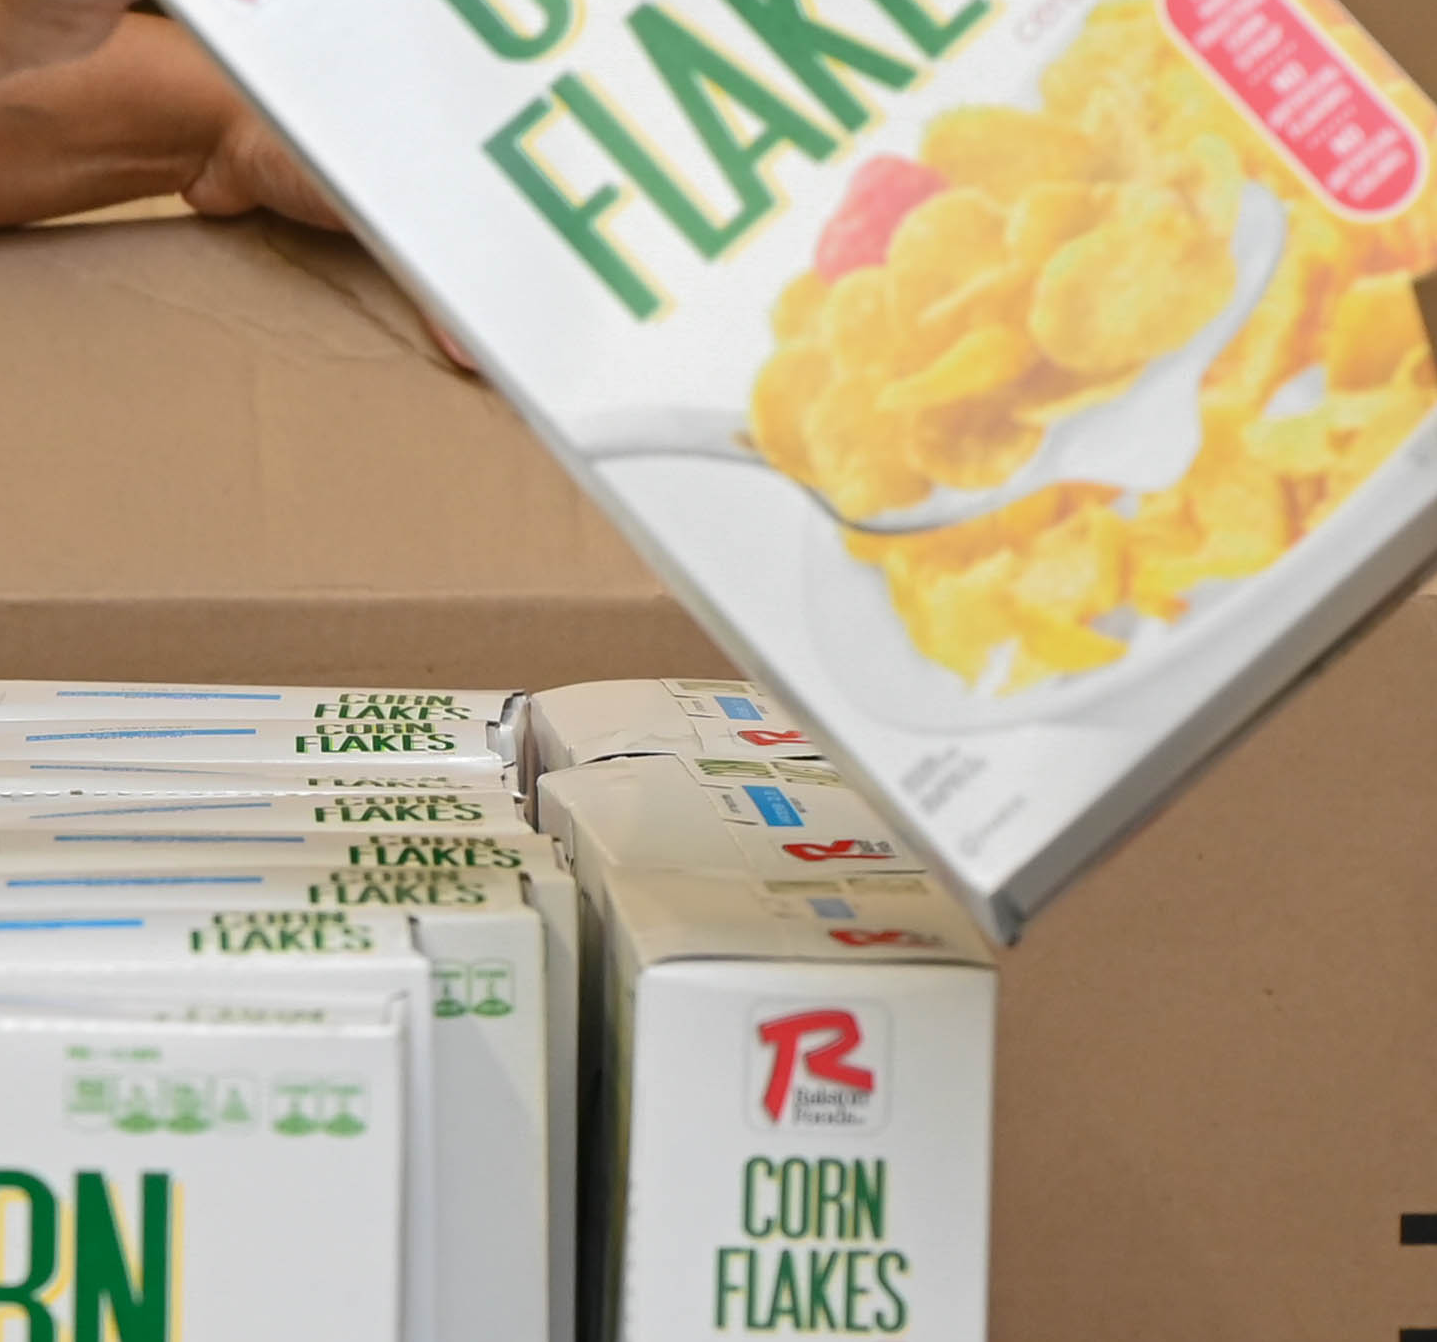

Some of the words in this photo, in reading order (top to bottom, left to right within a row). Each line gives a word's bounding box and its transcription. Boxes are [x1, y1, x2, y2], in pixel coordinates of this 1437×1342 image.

[295, 734, 457, 754] FLAKES
[314, 804, 484, 824] FLAKES
[348, 845, 523, 868] FLAKES
[740, 1157, 888, 1240] CORN
[714, 1247, 910, 1334] FLAKES
